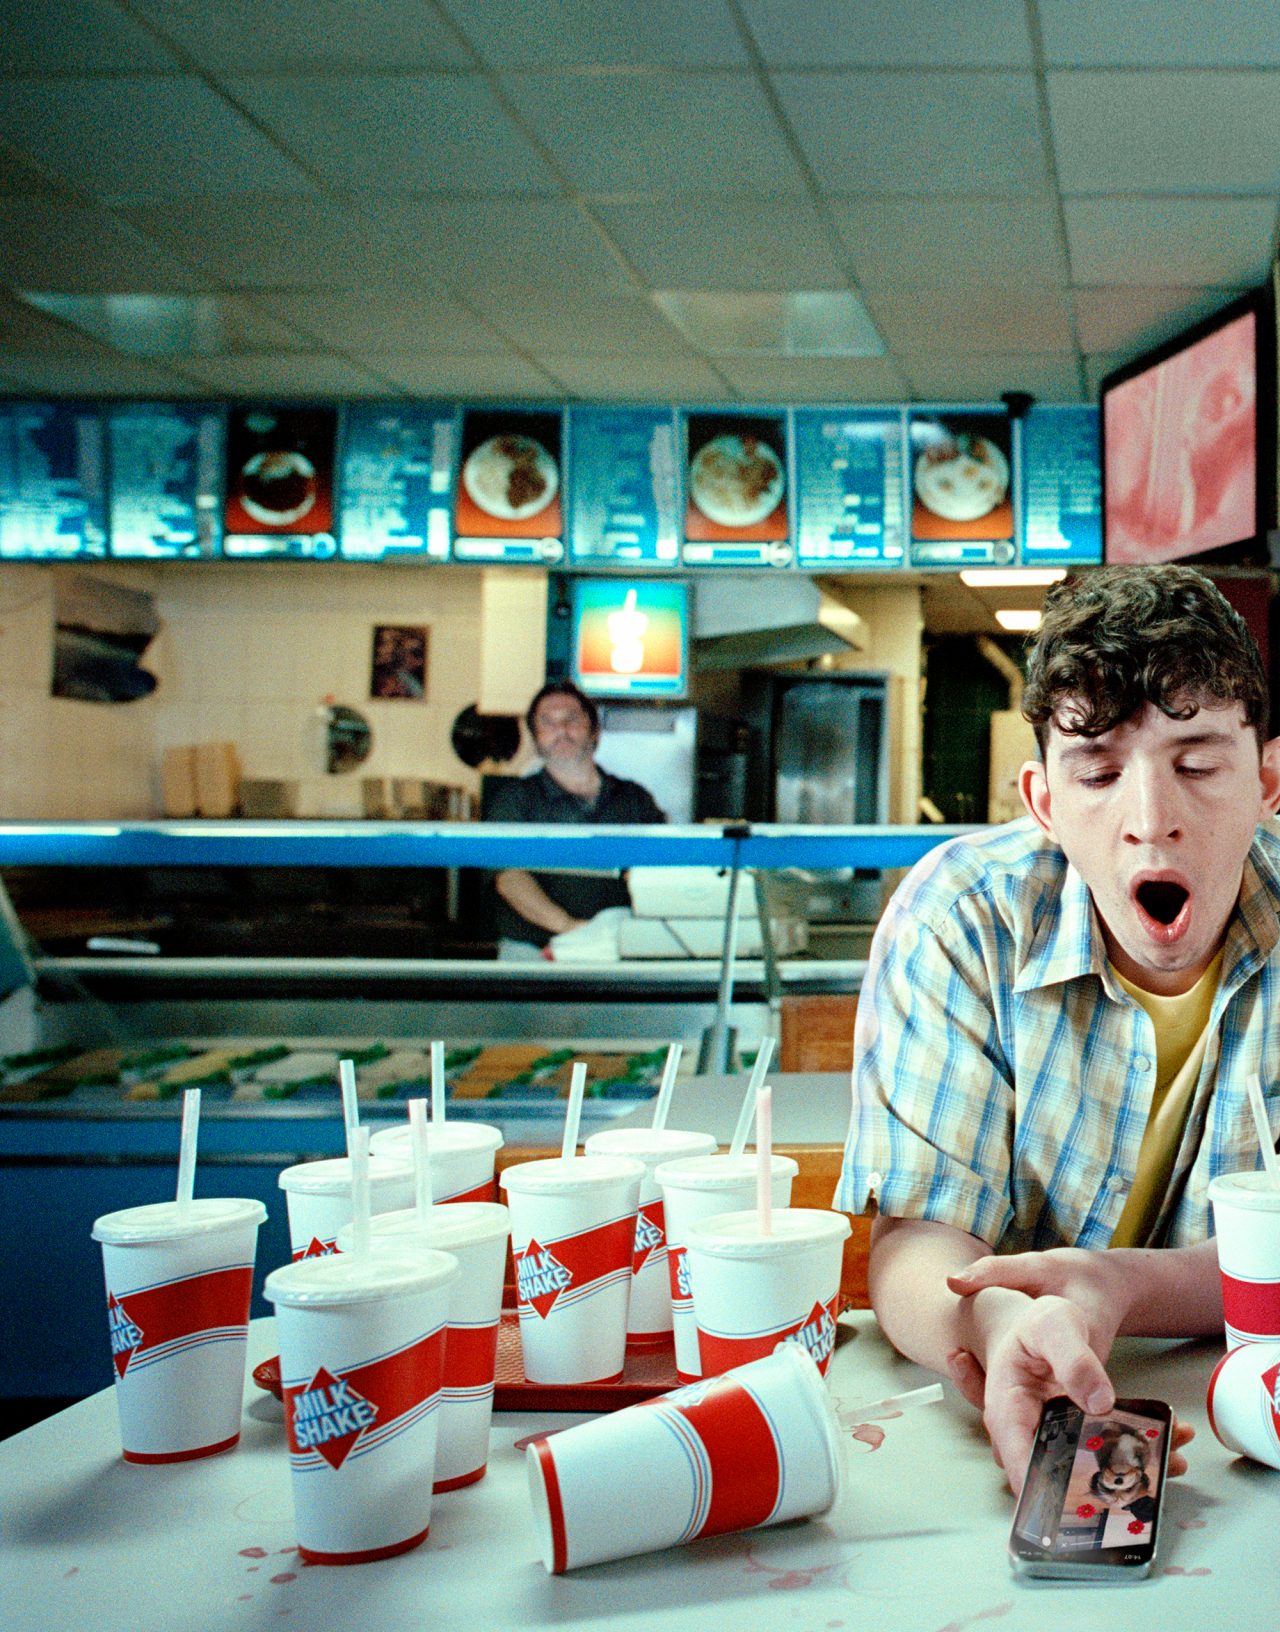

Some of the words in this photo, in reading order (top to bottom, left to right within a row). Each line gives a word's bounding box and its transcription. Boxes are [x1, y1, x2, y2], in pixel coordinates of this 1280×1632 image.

[517, 1249, 557, 1281] MILK
[518, 1265, 572, 1302] SHAKE
[111, 1322, 143, 1355] AKE
[293, 1379, 359, 1421] MILK
[294, 1399, 377, 1450] SHAKE
